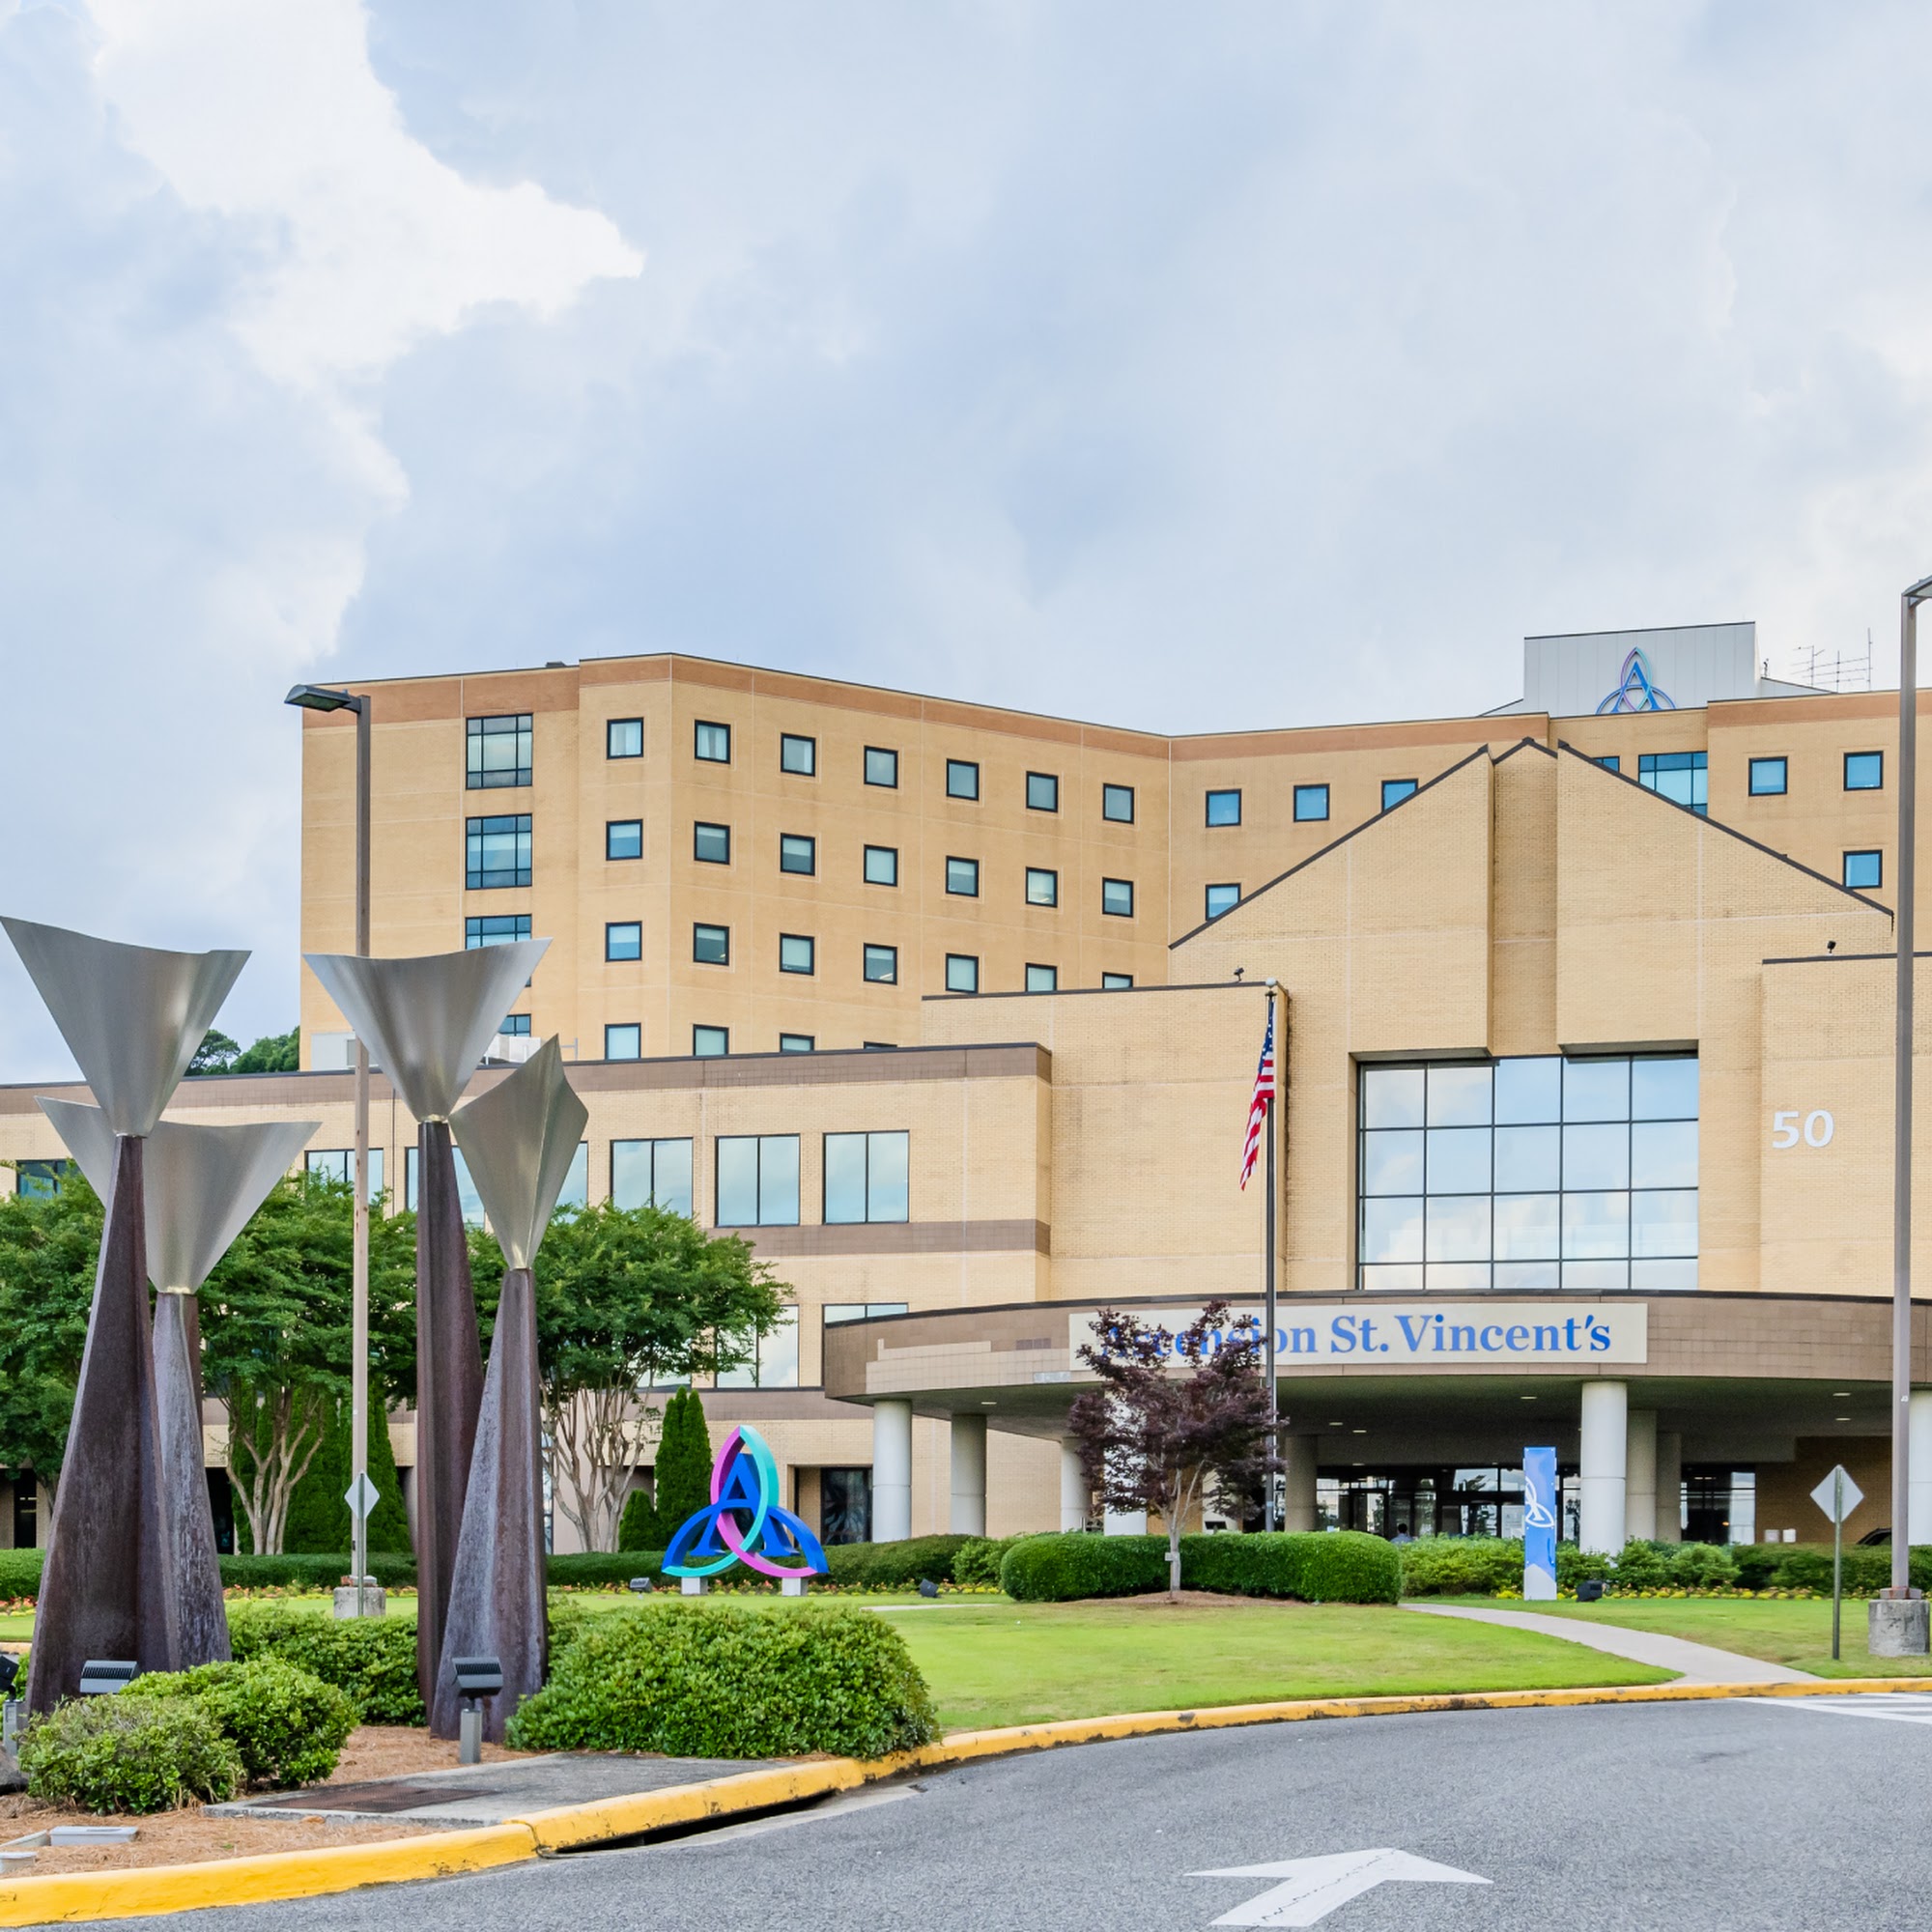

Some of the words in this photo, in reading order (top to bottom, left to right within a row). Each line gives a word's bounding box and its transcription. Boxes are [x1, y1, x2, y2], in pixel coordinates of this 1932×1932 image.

[1772, 1109, 1834, 1150] 50
[1330, 1315, 1389, 1353] St.
[1394, 1314, 1611, 1352] Vincent's
